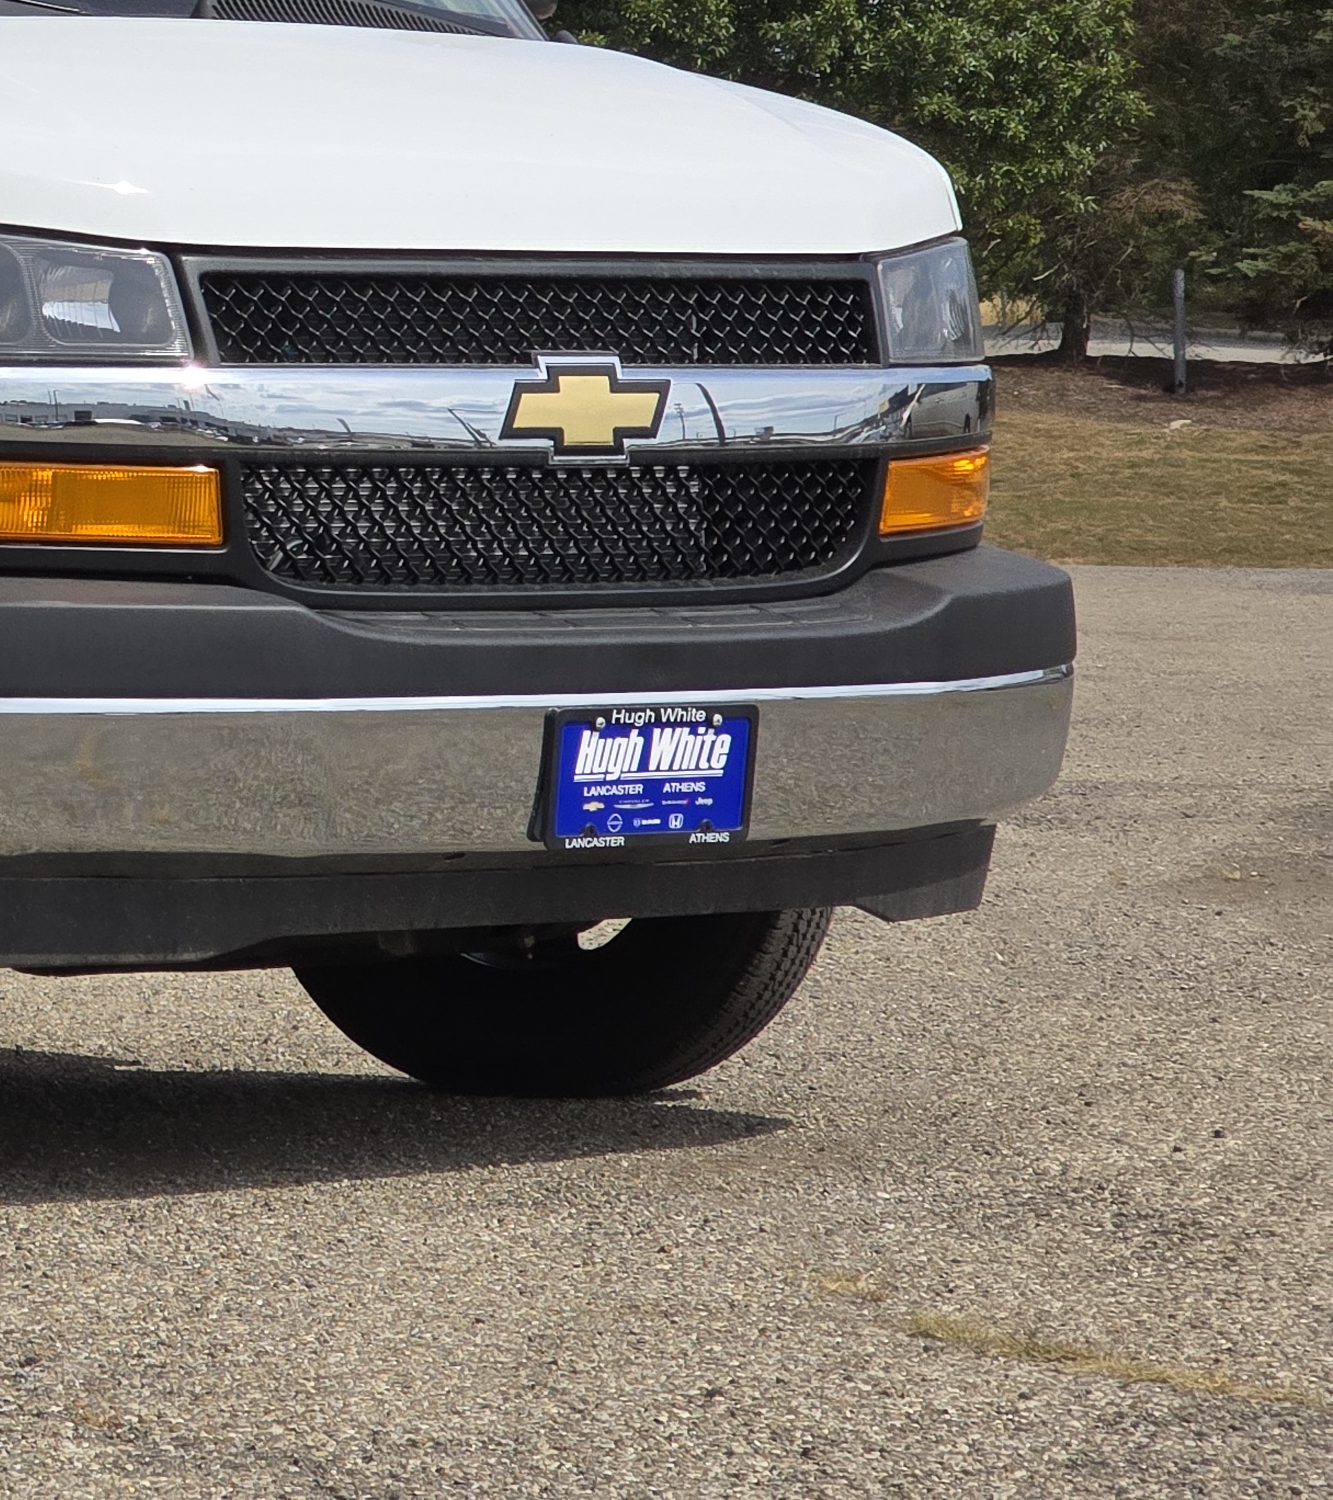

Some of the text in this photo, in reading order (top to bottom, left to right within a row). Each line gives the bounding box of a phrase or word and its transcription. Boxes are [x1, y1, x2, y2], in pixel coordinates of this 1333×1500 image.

[611, 707, 706, 726] Hugh White
[574, 727, 732, 781] Hugh White
[583, 781, 706, 797] LANCASTER ATHENS
[565, 832, 730, 849] LANCASTER ATHENS
